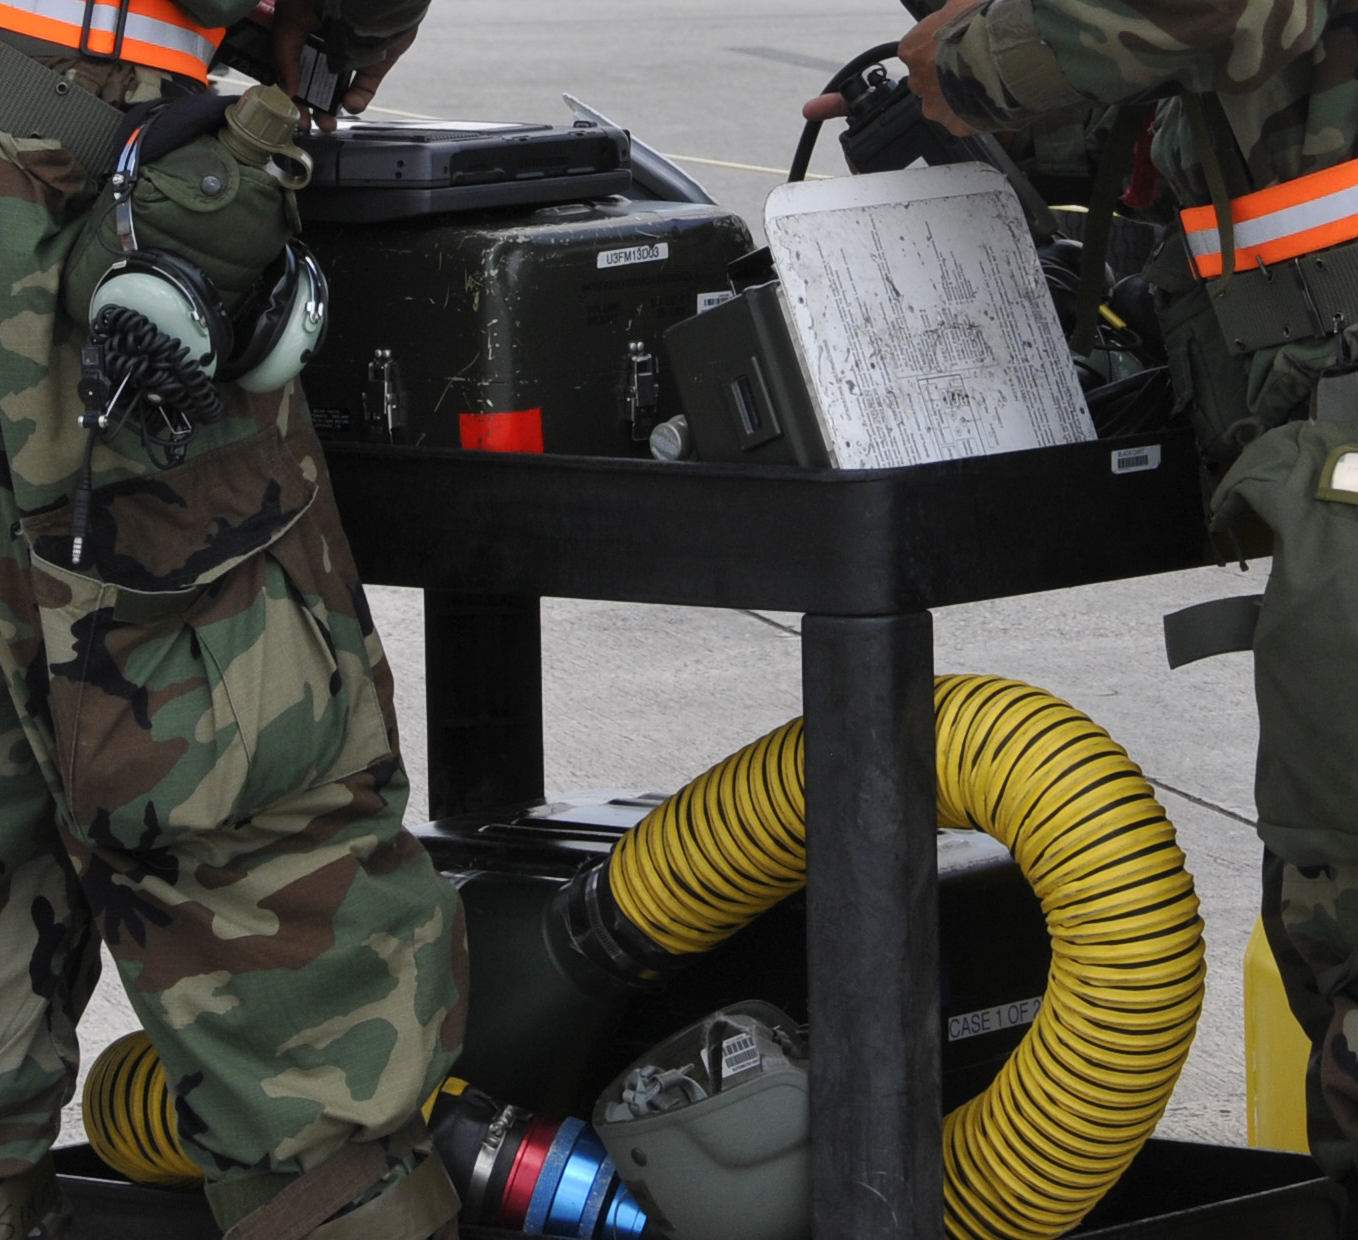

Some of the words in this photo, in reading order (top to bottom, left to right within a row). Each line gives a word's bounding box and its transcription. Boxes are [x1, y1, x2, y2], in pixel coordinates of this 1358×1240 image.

[950, 1011, 991, 1039] CASE
[996, 1010, 1002, 1028] 1
[1008, 1002, 1028, 1024] OF
[1033, 999, 1041, 1020] 2
